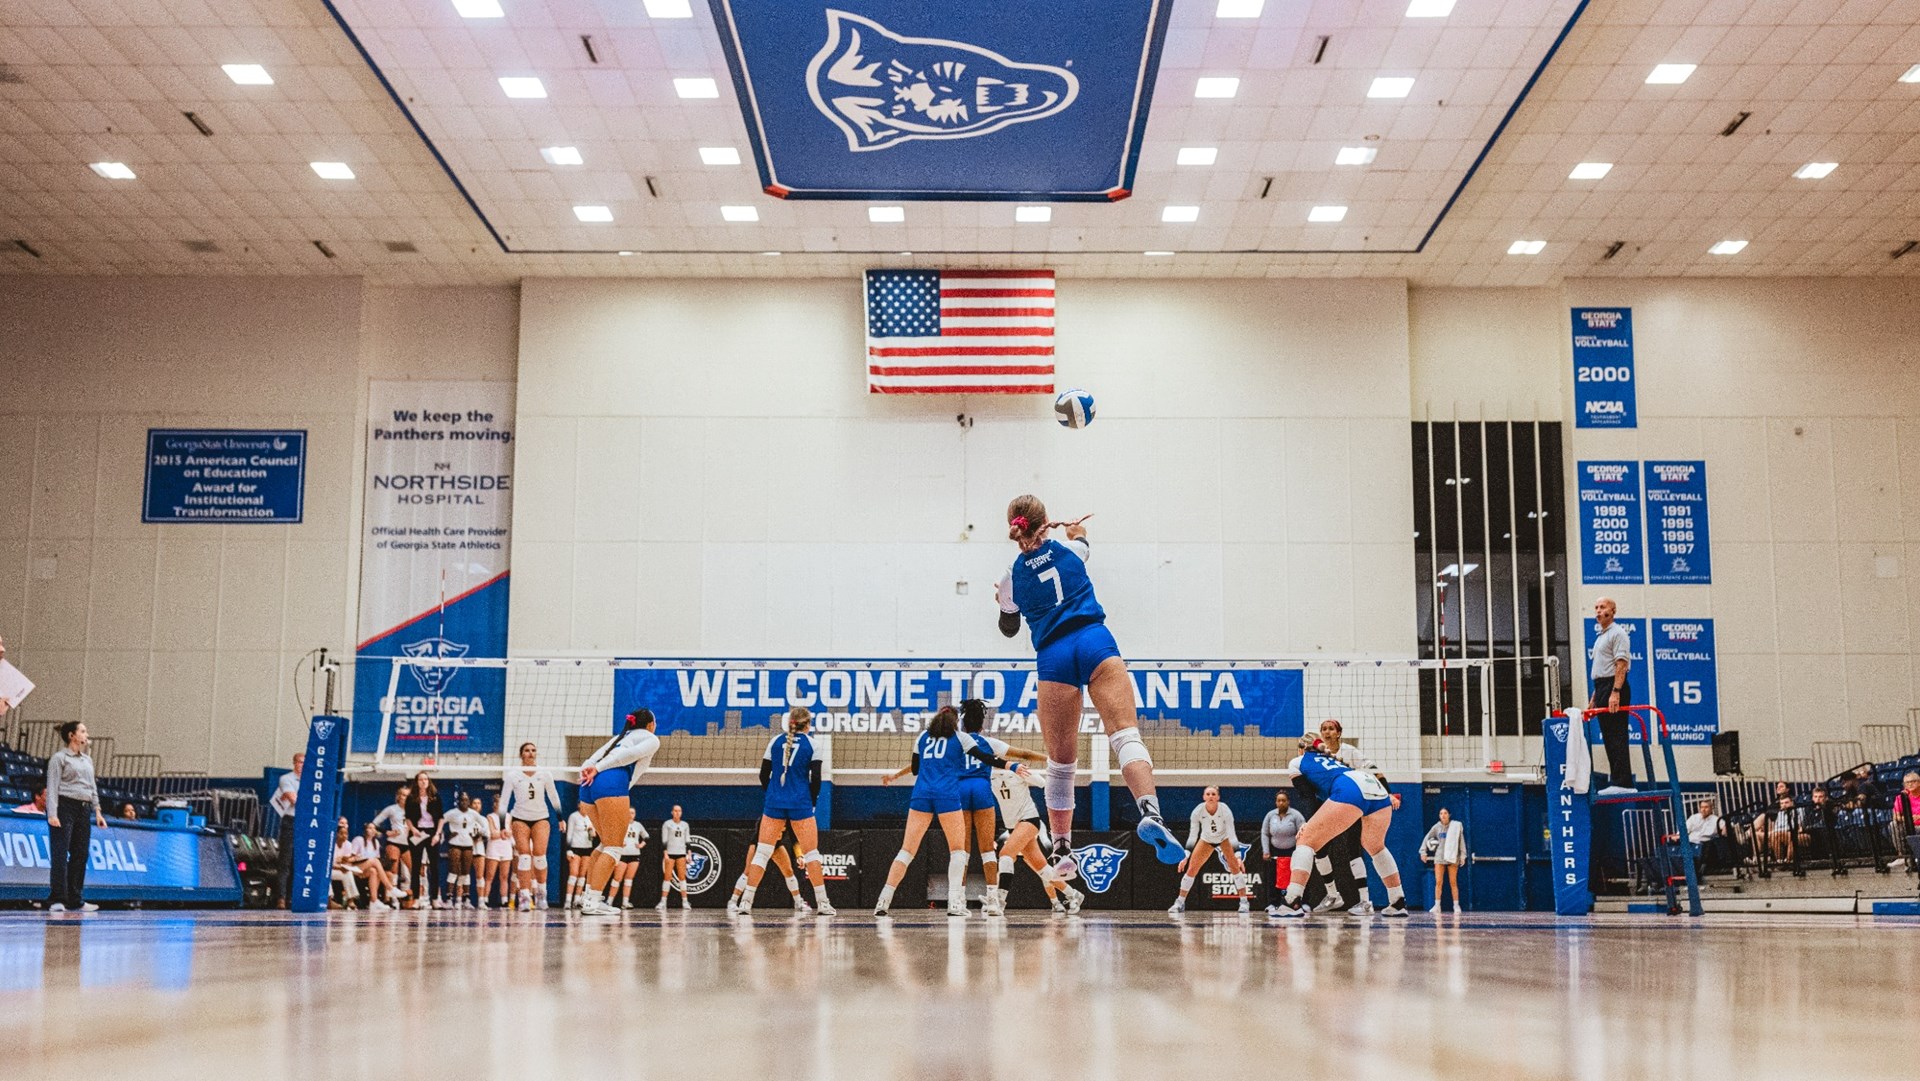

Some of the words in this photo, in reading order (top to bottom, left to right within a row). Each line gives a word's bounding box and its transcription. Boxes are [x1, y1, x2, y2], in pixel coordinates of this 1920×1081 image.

[1581, 312, 1622, 320] GEORGIA
[1588, 320, 1616, 328] STATE
[1578, 367, 1630, 382] 2000
[1585, 401, 1624, 413] NCAA
[393, 410, 418, 422] We
[423, 410, 462, 425] keep
[467, 410, 494, 422] the
[374, 428, 444, 440] Panthers
[449, 428, 515, 444] moving.
[154, 455, 182, 465] 2015
[185, 455, 247, 466] American
[250, 456, 298, 466] Council
[183, 469, 200, 478] on
[203, 467, 267, 478] Education
[1587, 465, 1629, 473] GEORGIA
[1653, 465, 1695, 473] GEORGIA
[374, 475, 511, 490] NORTHSIDE
[1593, 473, 1623, 481] STATE
[1660, 473, 1690, 481] STATE
[192, 483, 234, 493] Award
[238, 483, 257, 493] for
[184, 495, 264, 505] Institutional
[398, 494, 485, 504] HOSPITAL
[173, 506, 274, 517] Transformation
[1594, 505, 1626, 516] 1998
[1662, 505, 1691, 516] 1991
[1593, 518, 1629, 529] 2000
[1661, 518, 1694, 529] 1995
[371, 527, 407, 536] Official
[409, 527, 441, 536] Health
[443, 527, 465, 536] Care
[468, 527, 507, 536] Provider
[1595, 531, 1627, 541] 2001
[1661, 531, 1694, 541] 1996
[377, 541, 388, 549] of
[391, 541, 429, 552] Georgia
[431, 541, 456, 549] State
[459, 541, 501, 550] Athletics
[1594, 543, 1630, 554] 2002
[1663, 543, 1695, 554] 1997
[1037, 566, 1064, 607] 7
[1661, 624, 1704, 632] GEORGIA
[1669, 632, 1698, 640] STATE
[677, 670, 929, 708] WELCOME
[941, 670, 1006, 708] TO
[1018, 671, 1245, 709] ANTA
[1668, 681, 1702, 704] 15
[379, 696, 485, 715] GEORGIA
[395, 715, 469, 734] STATE
[1671, 732, 1705, 740] MUNGO
[923, 737, 947, 759] 20
[782, 743, 800, 766] 17
[964, 751, 983, 769] 14
[310, 746, 325, 828] GEORGIA
[0, 832, 147, 873] VOLBALL
[303, 840, 316, 897] STATE
[1203, 873, 1262, 884] GEOIA
[1212, 885, 1253, 895] STAE
